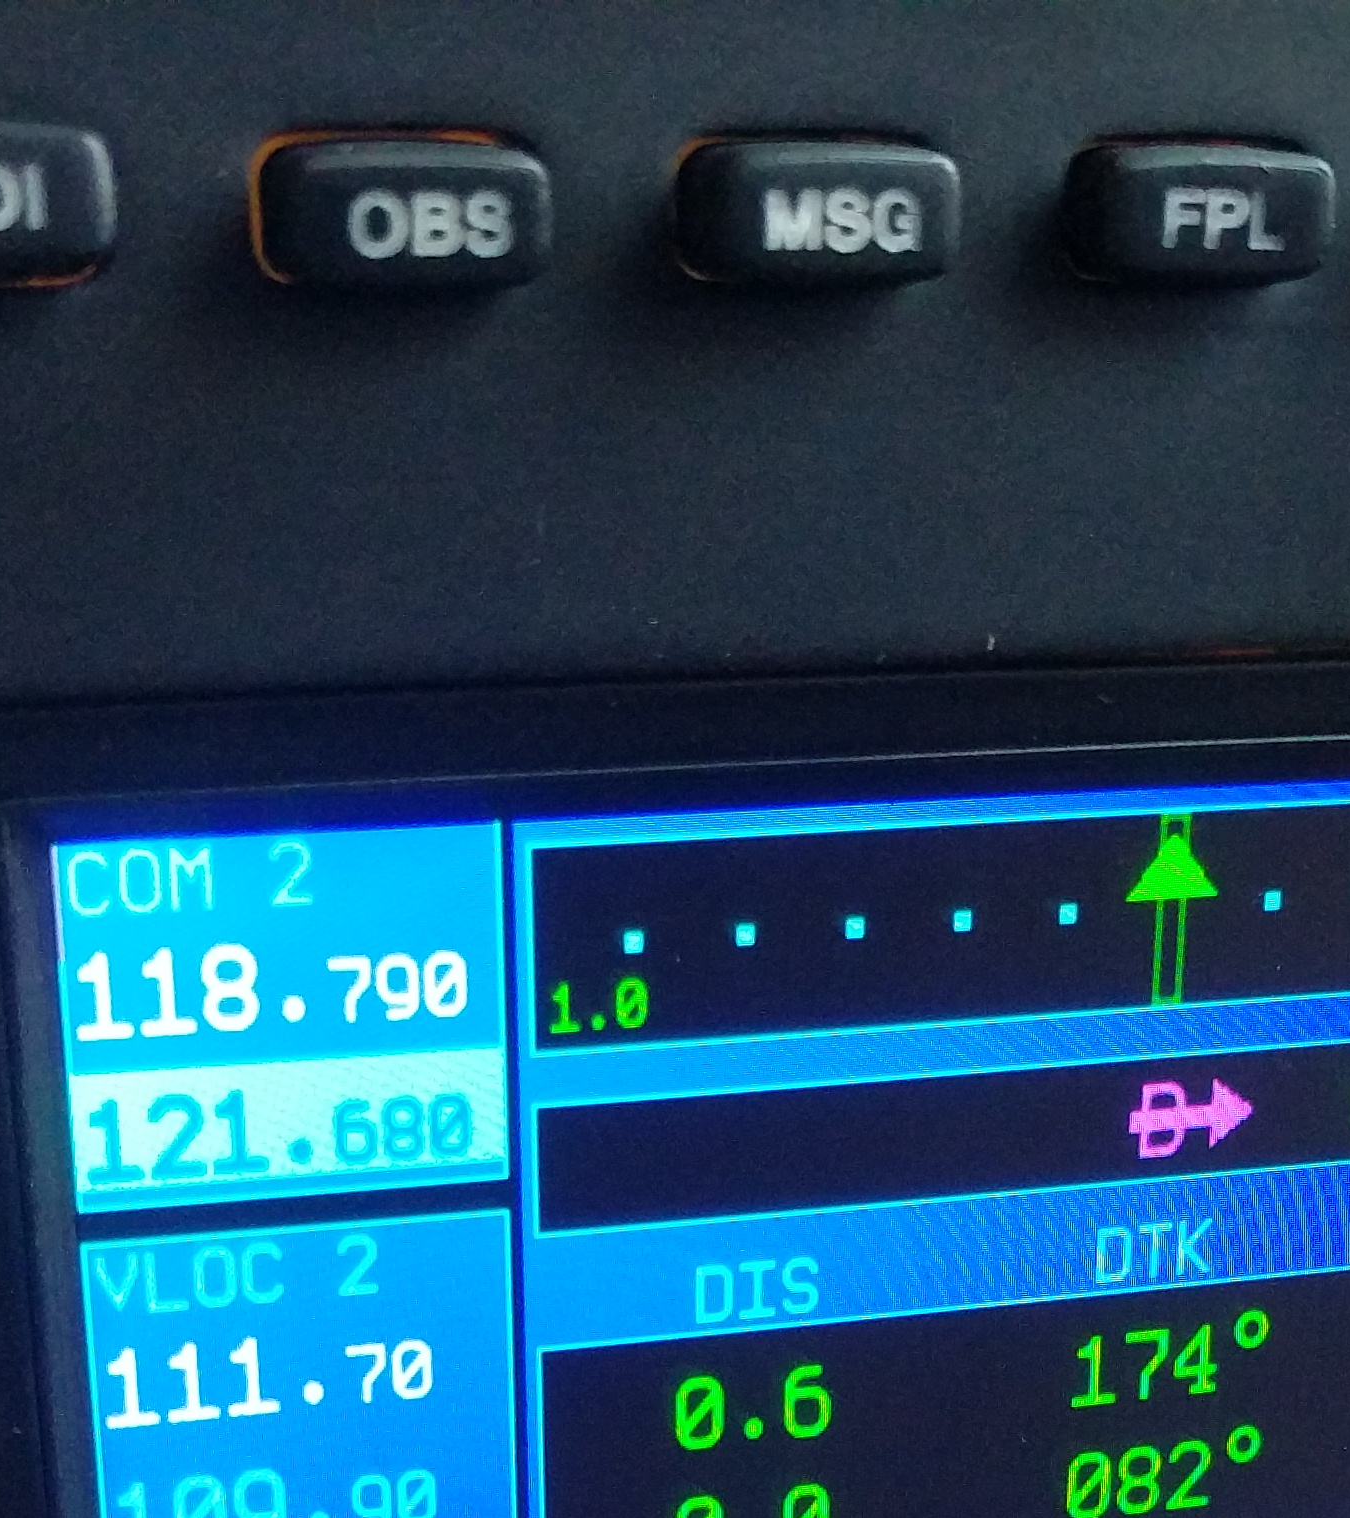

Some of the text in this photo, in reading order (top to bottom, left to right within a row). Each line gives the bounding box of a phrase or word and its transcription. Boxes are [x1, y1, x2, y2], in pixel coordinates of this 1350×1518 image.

[345, 186, 514, 261] OBS
[761, 186, 924, 253] MSG
[1160, 185, 1285, 254] FPL
[65, 841, 314, 919] COM 2
[74, 942, 470, 1044] 118.790
[548, 975, 650, 1036] 1.0
[85, 1090, 473, 1185] 121.680
[93, 1233, 380, 1315] VLOC 2
[1094, 1217, 1217, 1285] DTK
[692, 1256, 822, 1325] DIS
[104, 1335, 435, 1430] 111.70
[1070, 1307, 1271, 1408] 174°
[672, 1364, 835, 1452] 0.6
